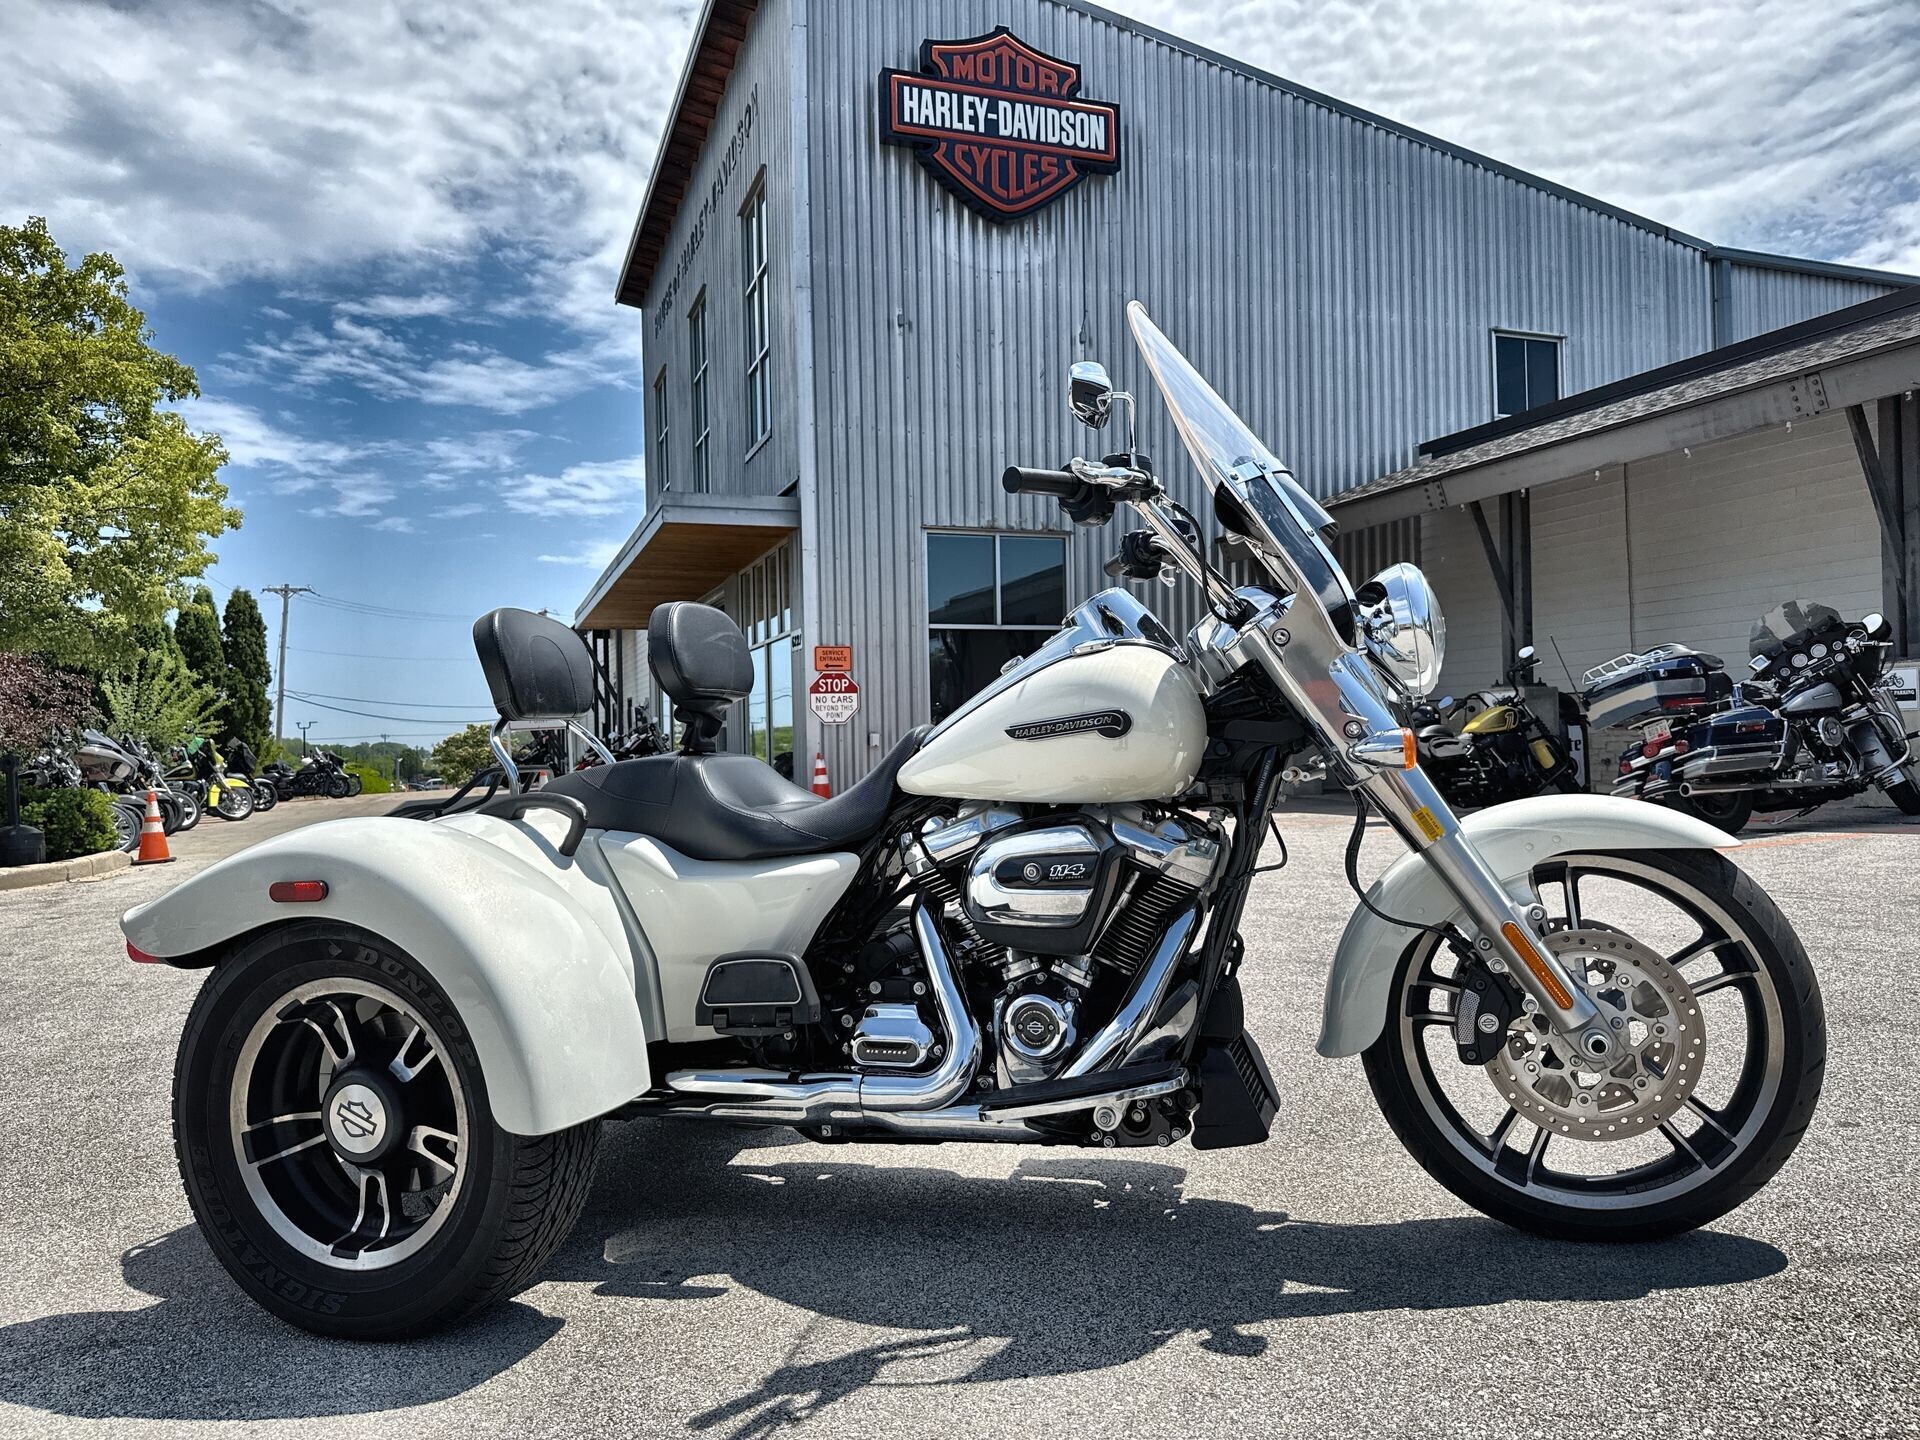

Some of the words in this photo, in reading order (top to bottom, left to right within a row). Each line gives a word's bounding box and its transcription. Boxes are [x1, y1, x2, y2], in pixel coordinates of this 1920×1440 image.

[953, 46, 1059, 95] MOTOR
[903, 86, 1105, 150] HARLEY-DAVIDSON
[954, 144, 1059, 199] CYCLES
[818, 679, 849, 692] STOP
[1014, 715, 1113, 738] HARLEY-DAVIDSON
[1049, 863, 1086, 877] 114
[354, 945, 477, 1067] DUNLOP
